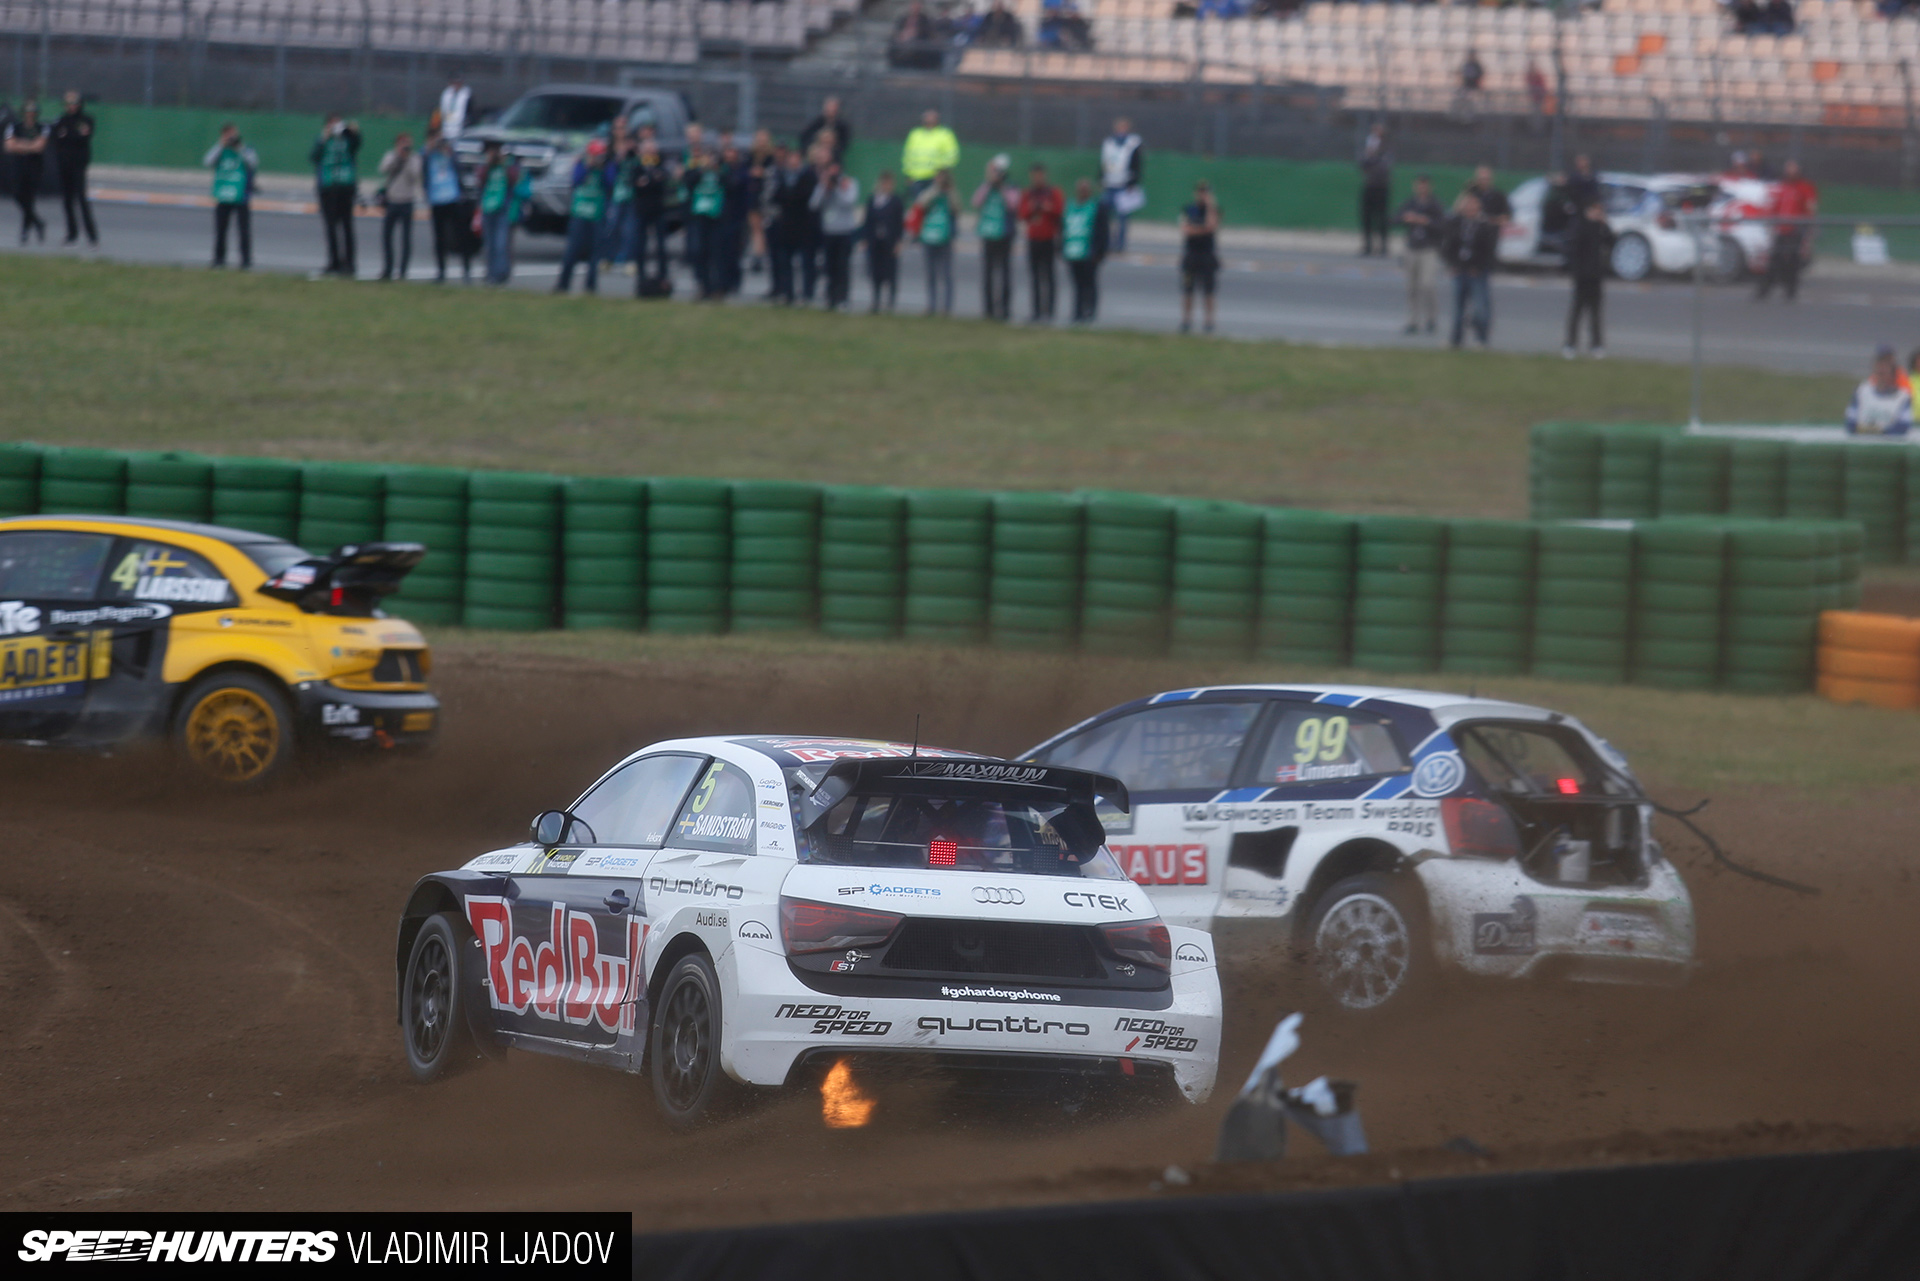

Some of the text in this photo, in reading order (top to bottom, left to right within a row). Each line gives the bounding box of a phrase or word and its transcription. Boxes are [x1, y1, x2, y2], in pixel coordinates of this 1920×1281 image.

[111, 553, 141, 591] 4
[1293, 715, 1349, 763] 99
[943, 763, 1048, 780] MAXIMUM
[692, 763, 724, 813] 5
[1182, 802, 1440, 824] Volkswagen Team Sweden
[692, 813, 755, 840] SANDSTRÖM
[600, 855, 639, 868] GADGETS
[649, 876, 744, 900] quattro
[838, 883, 941, 896] SP GADGETS
[1063, 891, 1134, 913] CTEK
[696, 912, 728, 928] Audi.se
[464, 894, 567, 1022] Red
[940, 985, 1062, 1002] #gohardorgohome
[774, 1003, 871, 1020] NEED FOR
[810, 1020, 893, 1036] SPEED
[917, 1016, 1090, 1036] quattro
[1113, 1017, 1185, 1037] NEED FOR
[1141, 1035, 1199, 1052] SPEED
